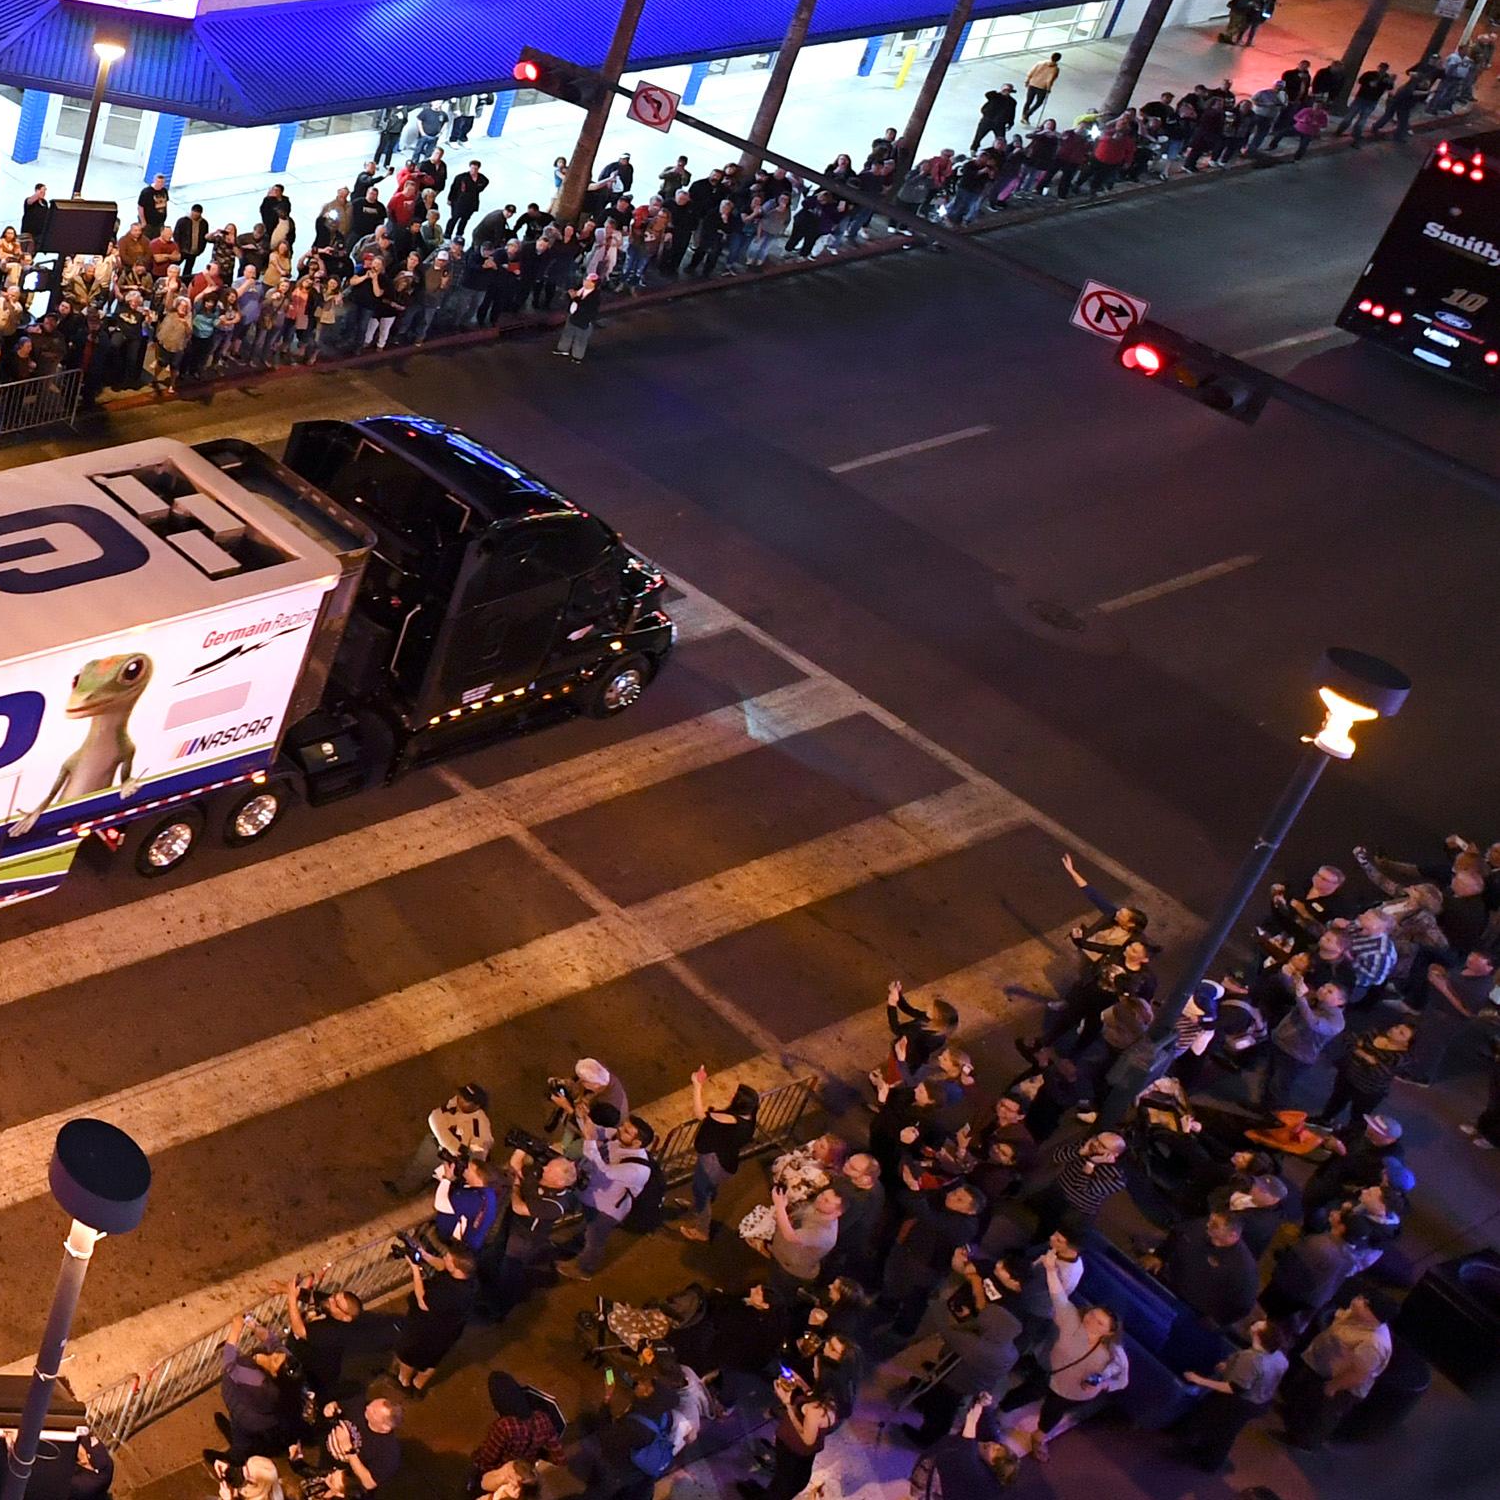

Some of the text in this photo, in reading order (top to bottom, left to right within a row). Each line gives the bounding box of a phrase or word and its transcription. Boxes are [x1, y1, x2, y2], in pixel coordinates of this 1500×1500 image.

[1441, 287, 1490, 313] 10
[202, 607, 320, 649] Germain Racing
[194, 715, 275, 753] NASCAR
